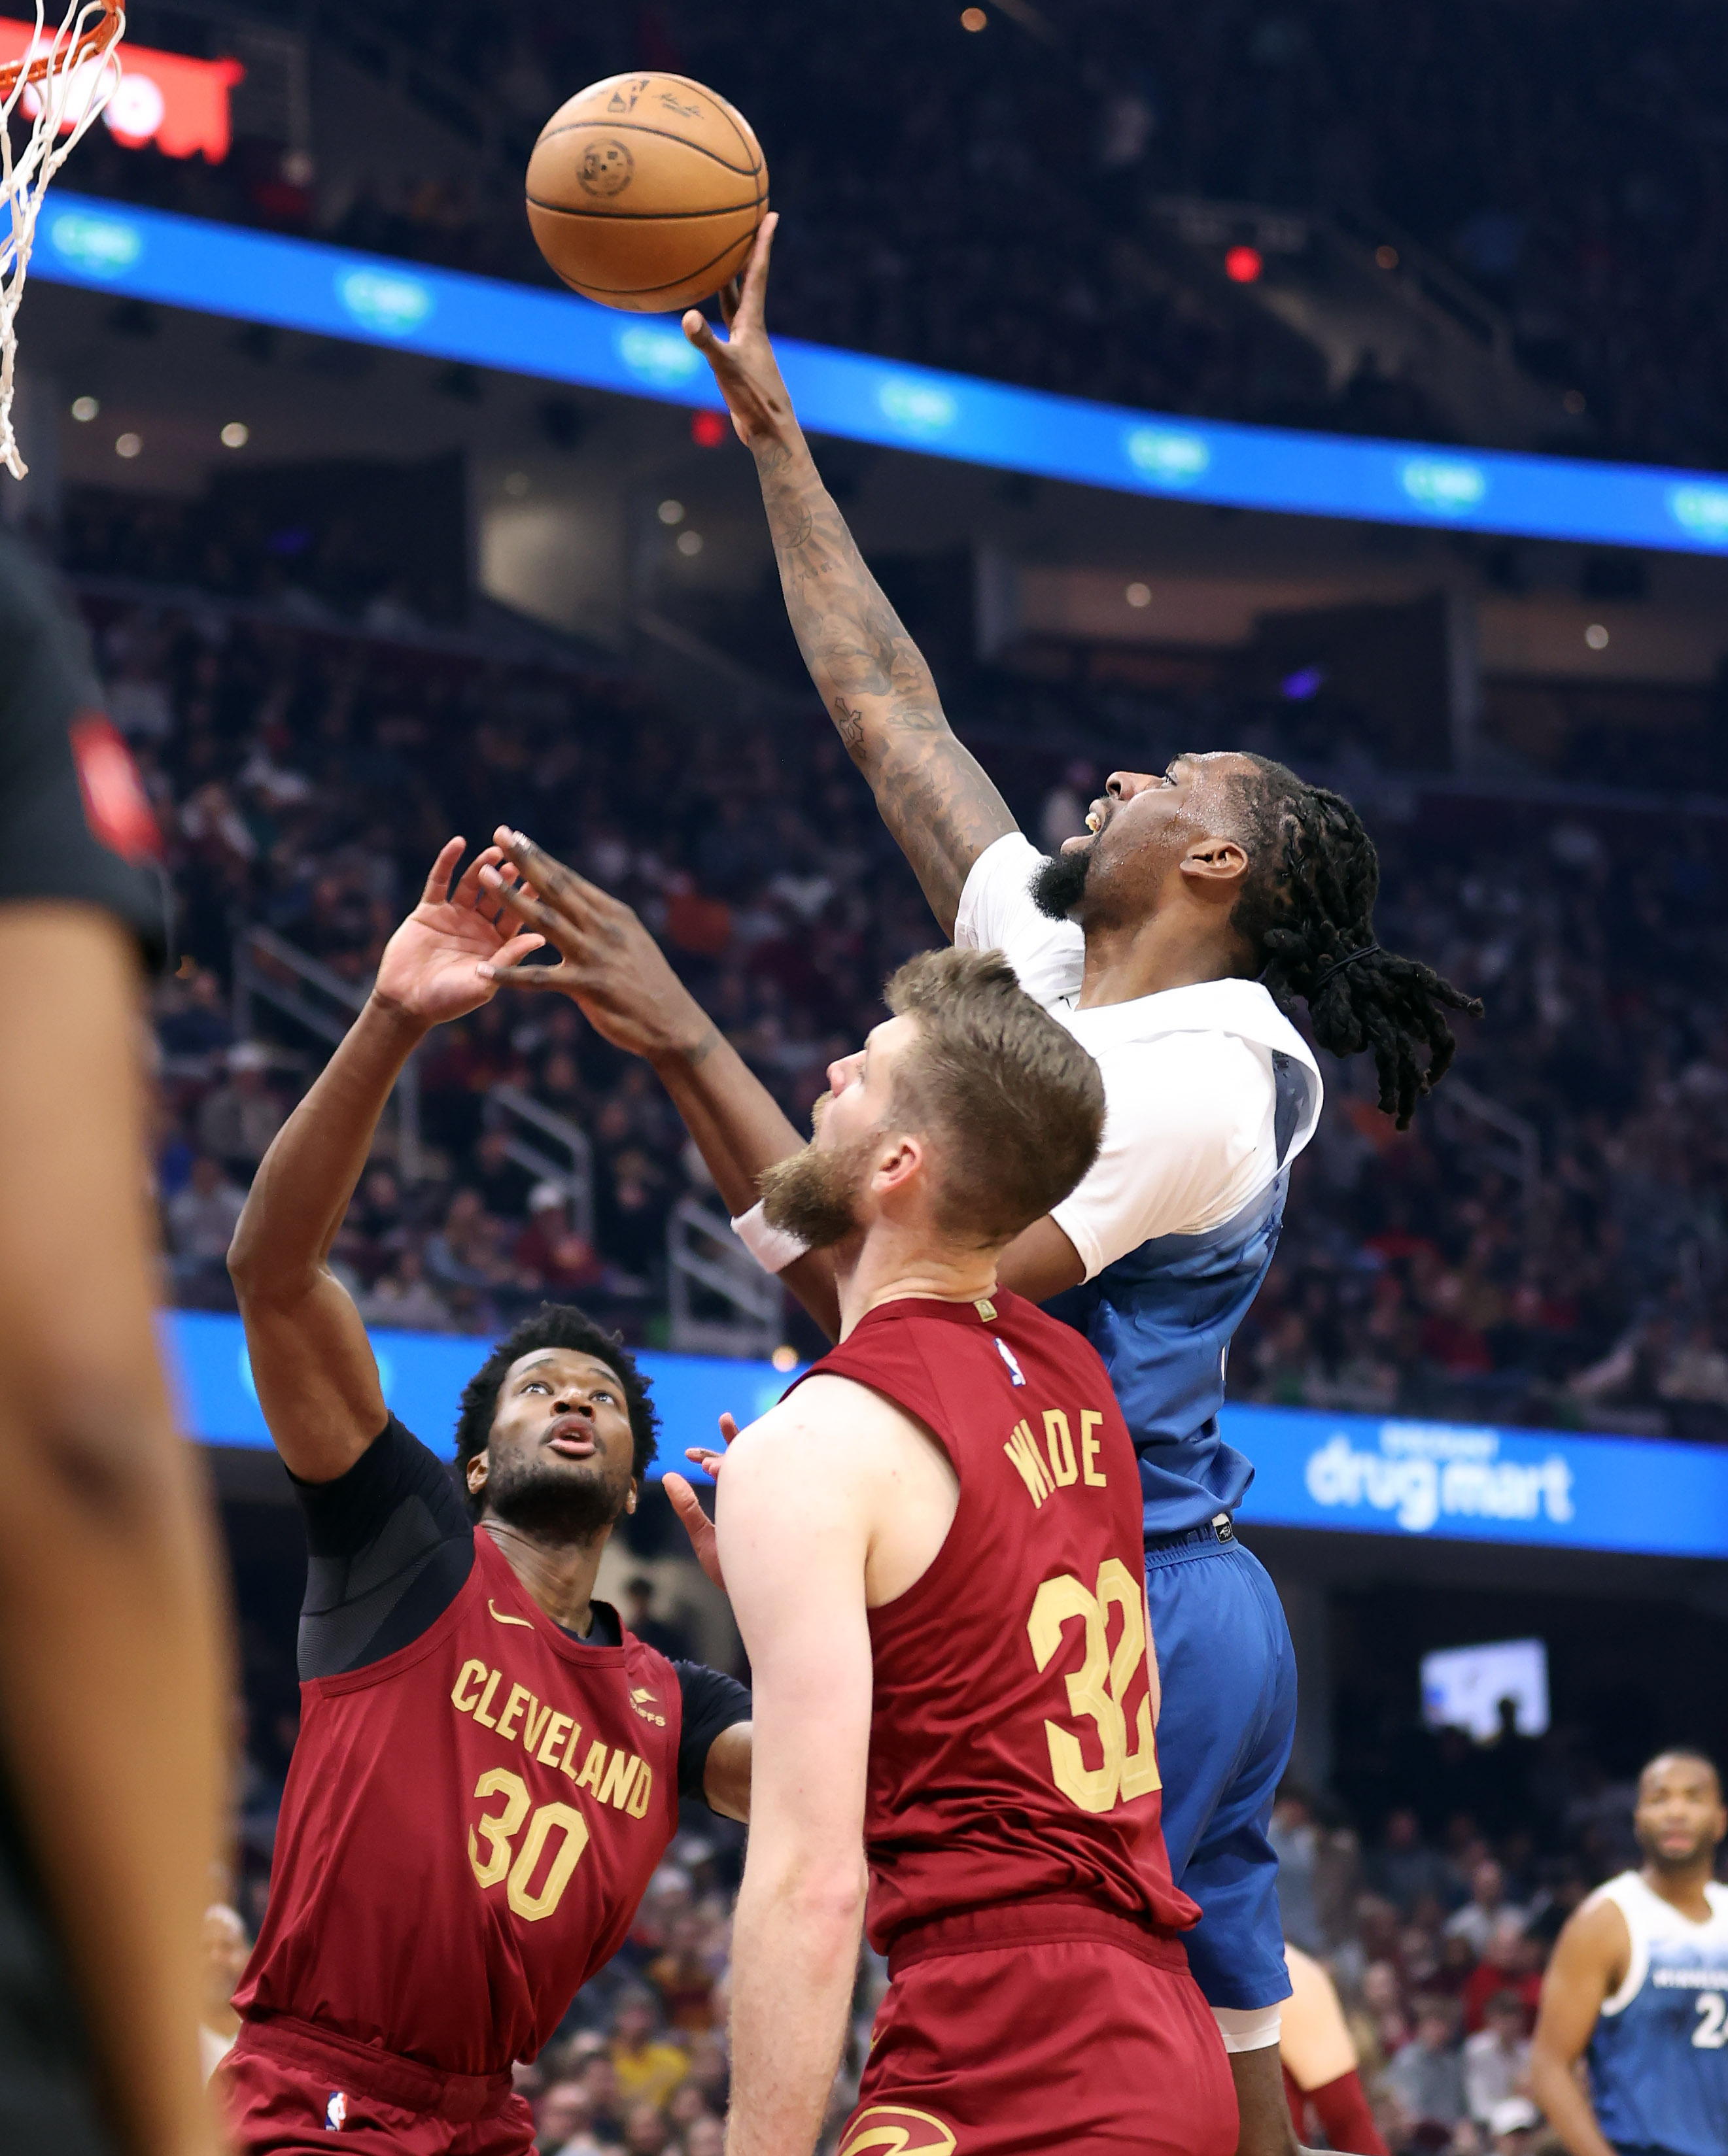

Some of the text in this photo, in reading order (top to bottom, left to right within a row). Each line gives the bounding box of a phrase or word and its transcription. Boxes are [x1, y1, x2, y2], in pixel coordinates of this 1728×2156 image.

[1305, 1430, 1439, 1533] drug
[1441, 1453, 1576, 1524] mart
[450, 1658, 653, 1820] CLEVELAND
[1026, 1558, 1163, 1813] 32
[467, 1767, 589, 1922] 30
[1691, 1991, 1728, 2048] 2
